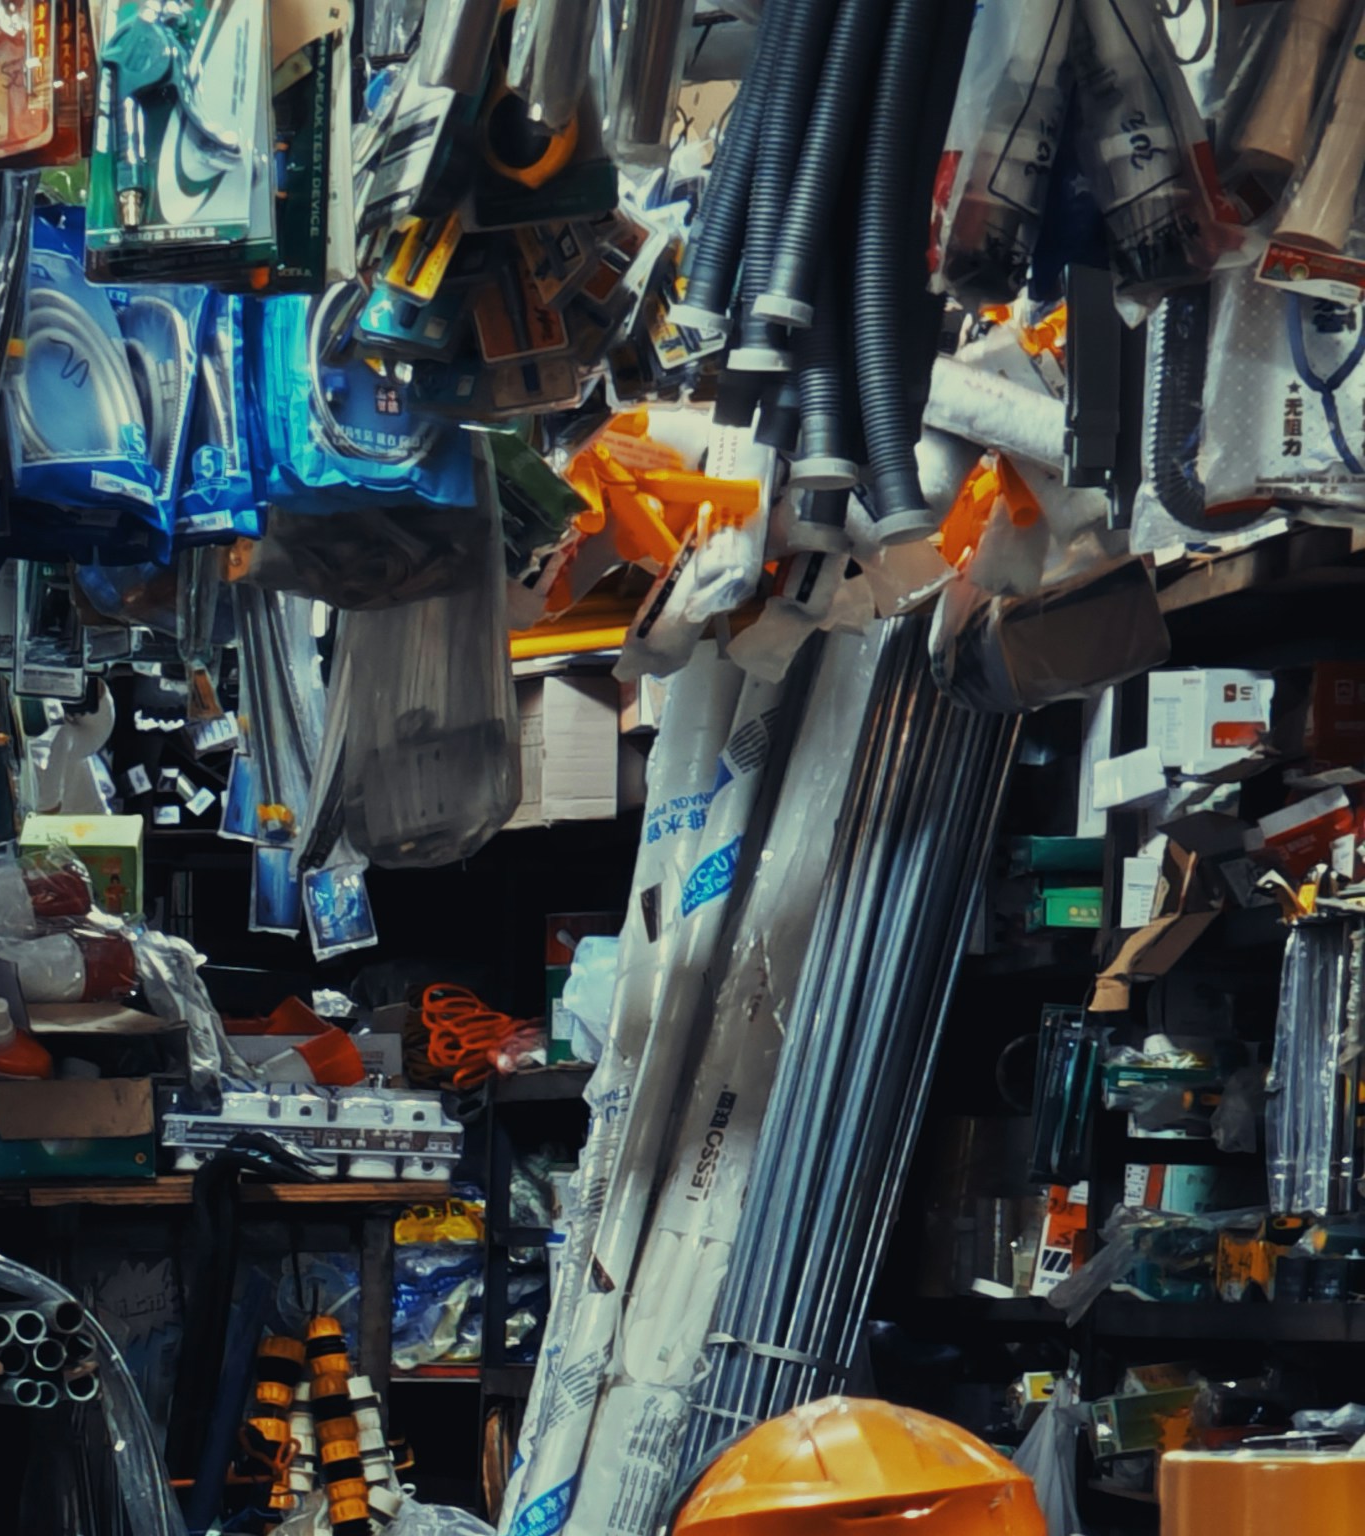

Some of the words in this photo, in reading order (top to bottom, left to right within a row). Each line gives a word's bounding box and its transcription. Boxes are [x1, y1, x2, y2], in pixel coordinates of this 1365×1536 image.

[310, 177, 322, 237] DEVICE
[1283, 397, 1303, 457] 无阻力
[200, 448, 214, 478] 5
